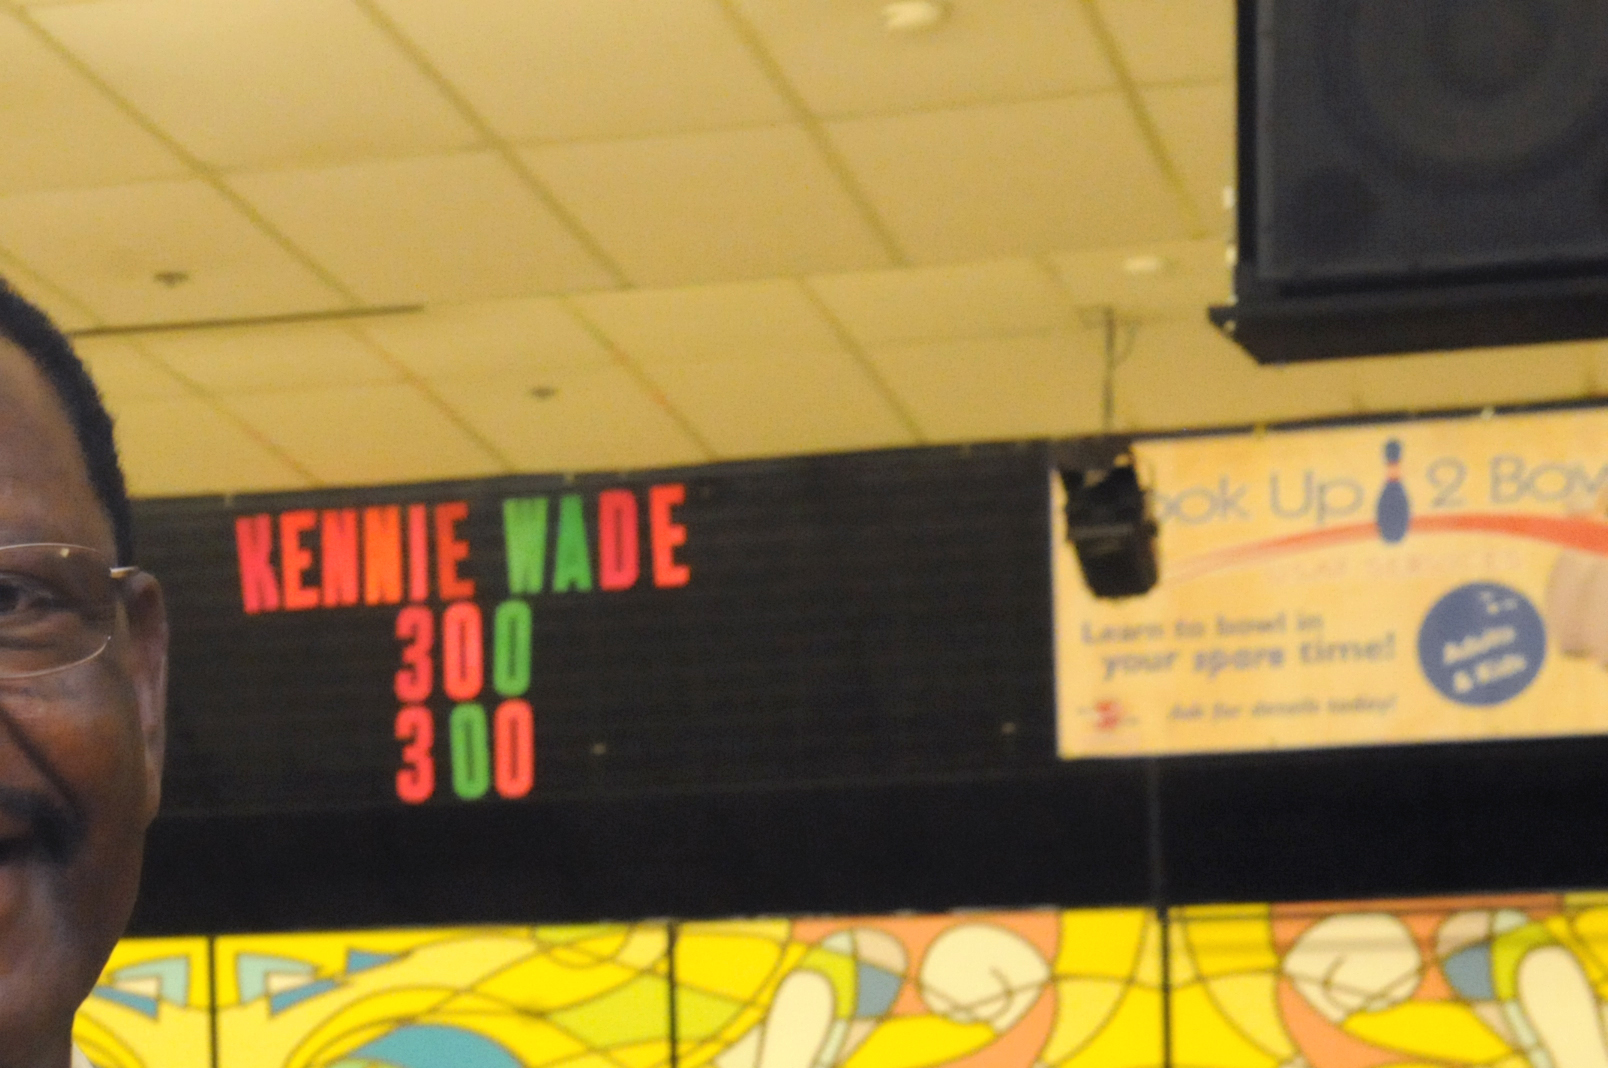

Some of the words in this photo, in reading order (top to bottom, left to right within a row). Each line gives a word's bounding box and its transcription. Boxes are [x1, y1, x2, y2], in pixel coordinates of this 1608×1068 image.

[1152, 472, 1250, 526] ook
[1269, 470, 1365, 524] Up
[1425, 456, 1468, 509] 2
[235, 501, 476, 615] KENNIE
[502, 482, 691, 595] WADE
[393, 598, 532, 703] 300
[1080, 619, 1165, 647] Learn
[1175, 615, 1206, 640] to
[1216, 611, 1286, 636] bowl
[1297, 609, 1324, 634] in
[1101, 649, 1180, 681] your
[1195, 644, 1286, 681] spare
[1300, 632, 1398, 667] time!
[394, 699, 536, 805] 300
